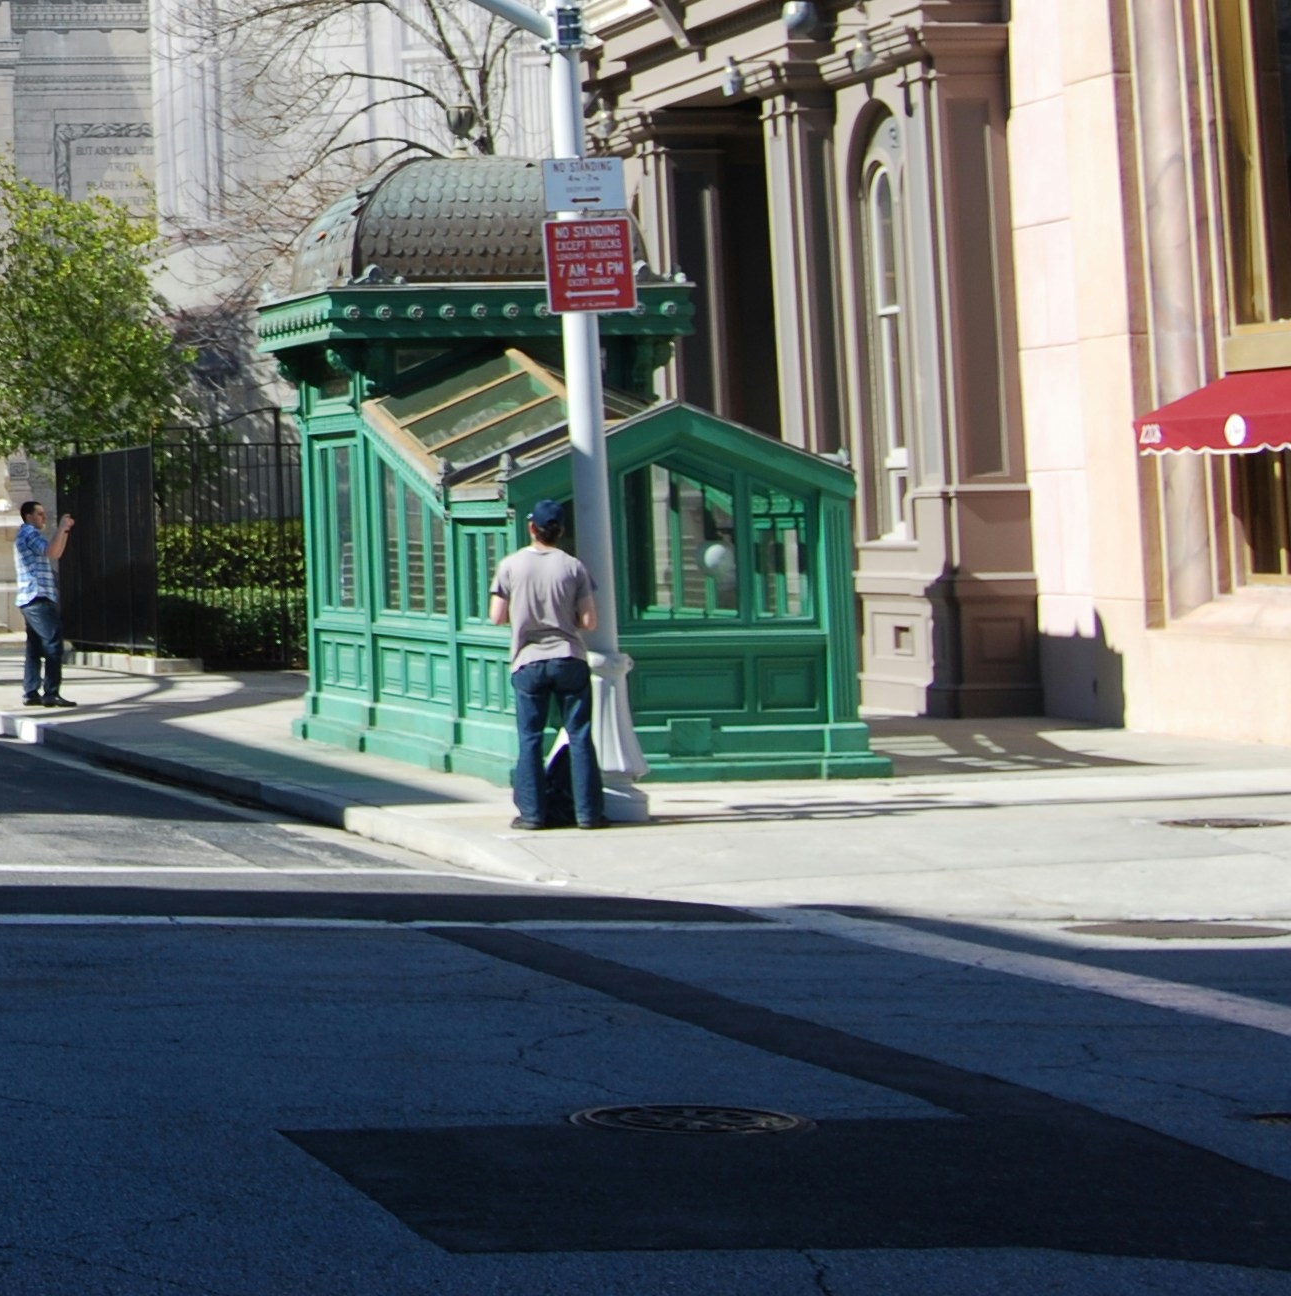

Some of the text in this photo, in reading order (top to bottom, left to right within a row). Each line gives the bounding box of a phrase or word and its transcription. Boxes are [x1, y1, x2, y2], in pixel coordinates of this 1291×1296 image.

[552, 161, 612, 173] NO STANDING
[554, 224, 621, 238] NO STANDING
[555, 239, 622, 251] EXCEPT TRUCKS
[557, 264, 566, 278] 7
[606, 261, 625, 274] PM
